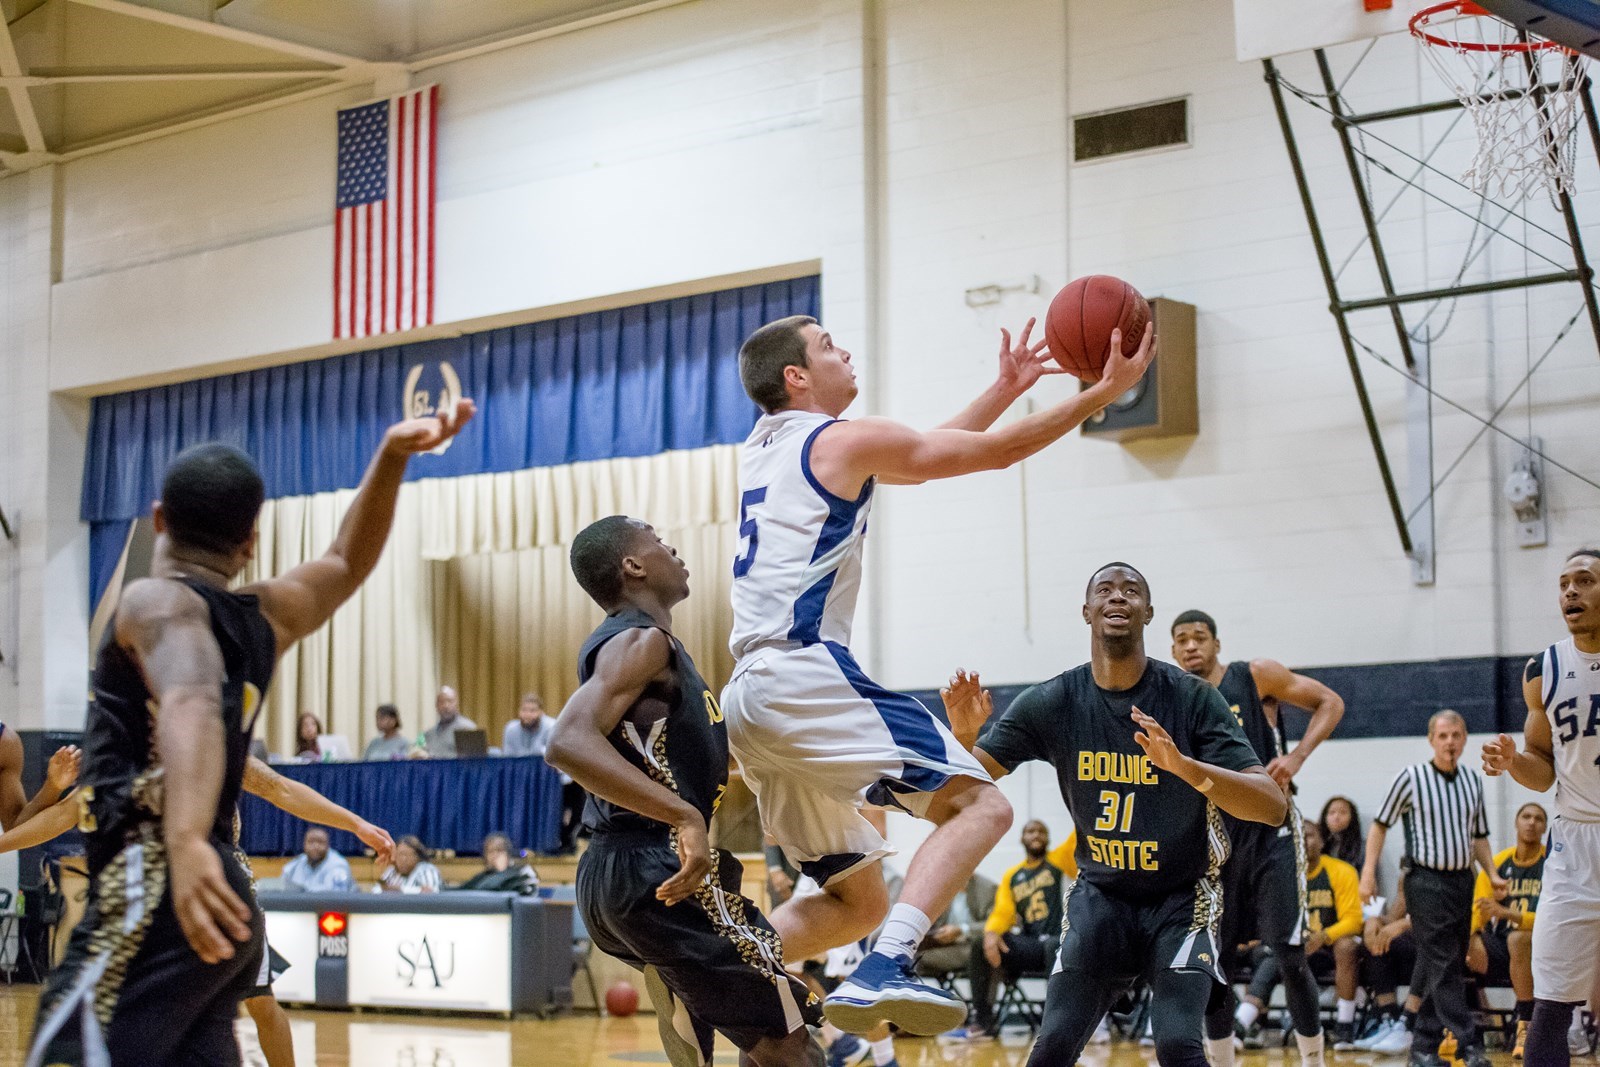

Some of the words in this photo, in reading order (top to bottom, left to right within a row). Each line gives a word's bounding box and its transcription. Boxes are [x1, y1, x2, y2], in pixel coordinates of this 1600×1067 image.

[733, 486, 768, 579] 5
[1078, 751, 1159, 785] BOWIE
[1095, 790, 1135, 833] 31
[1087, 835, 1158, 871] STATE
[320, 935, 348, 956] POSS
[397, 932, 455, 987] SAU
